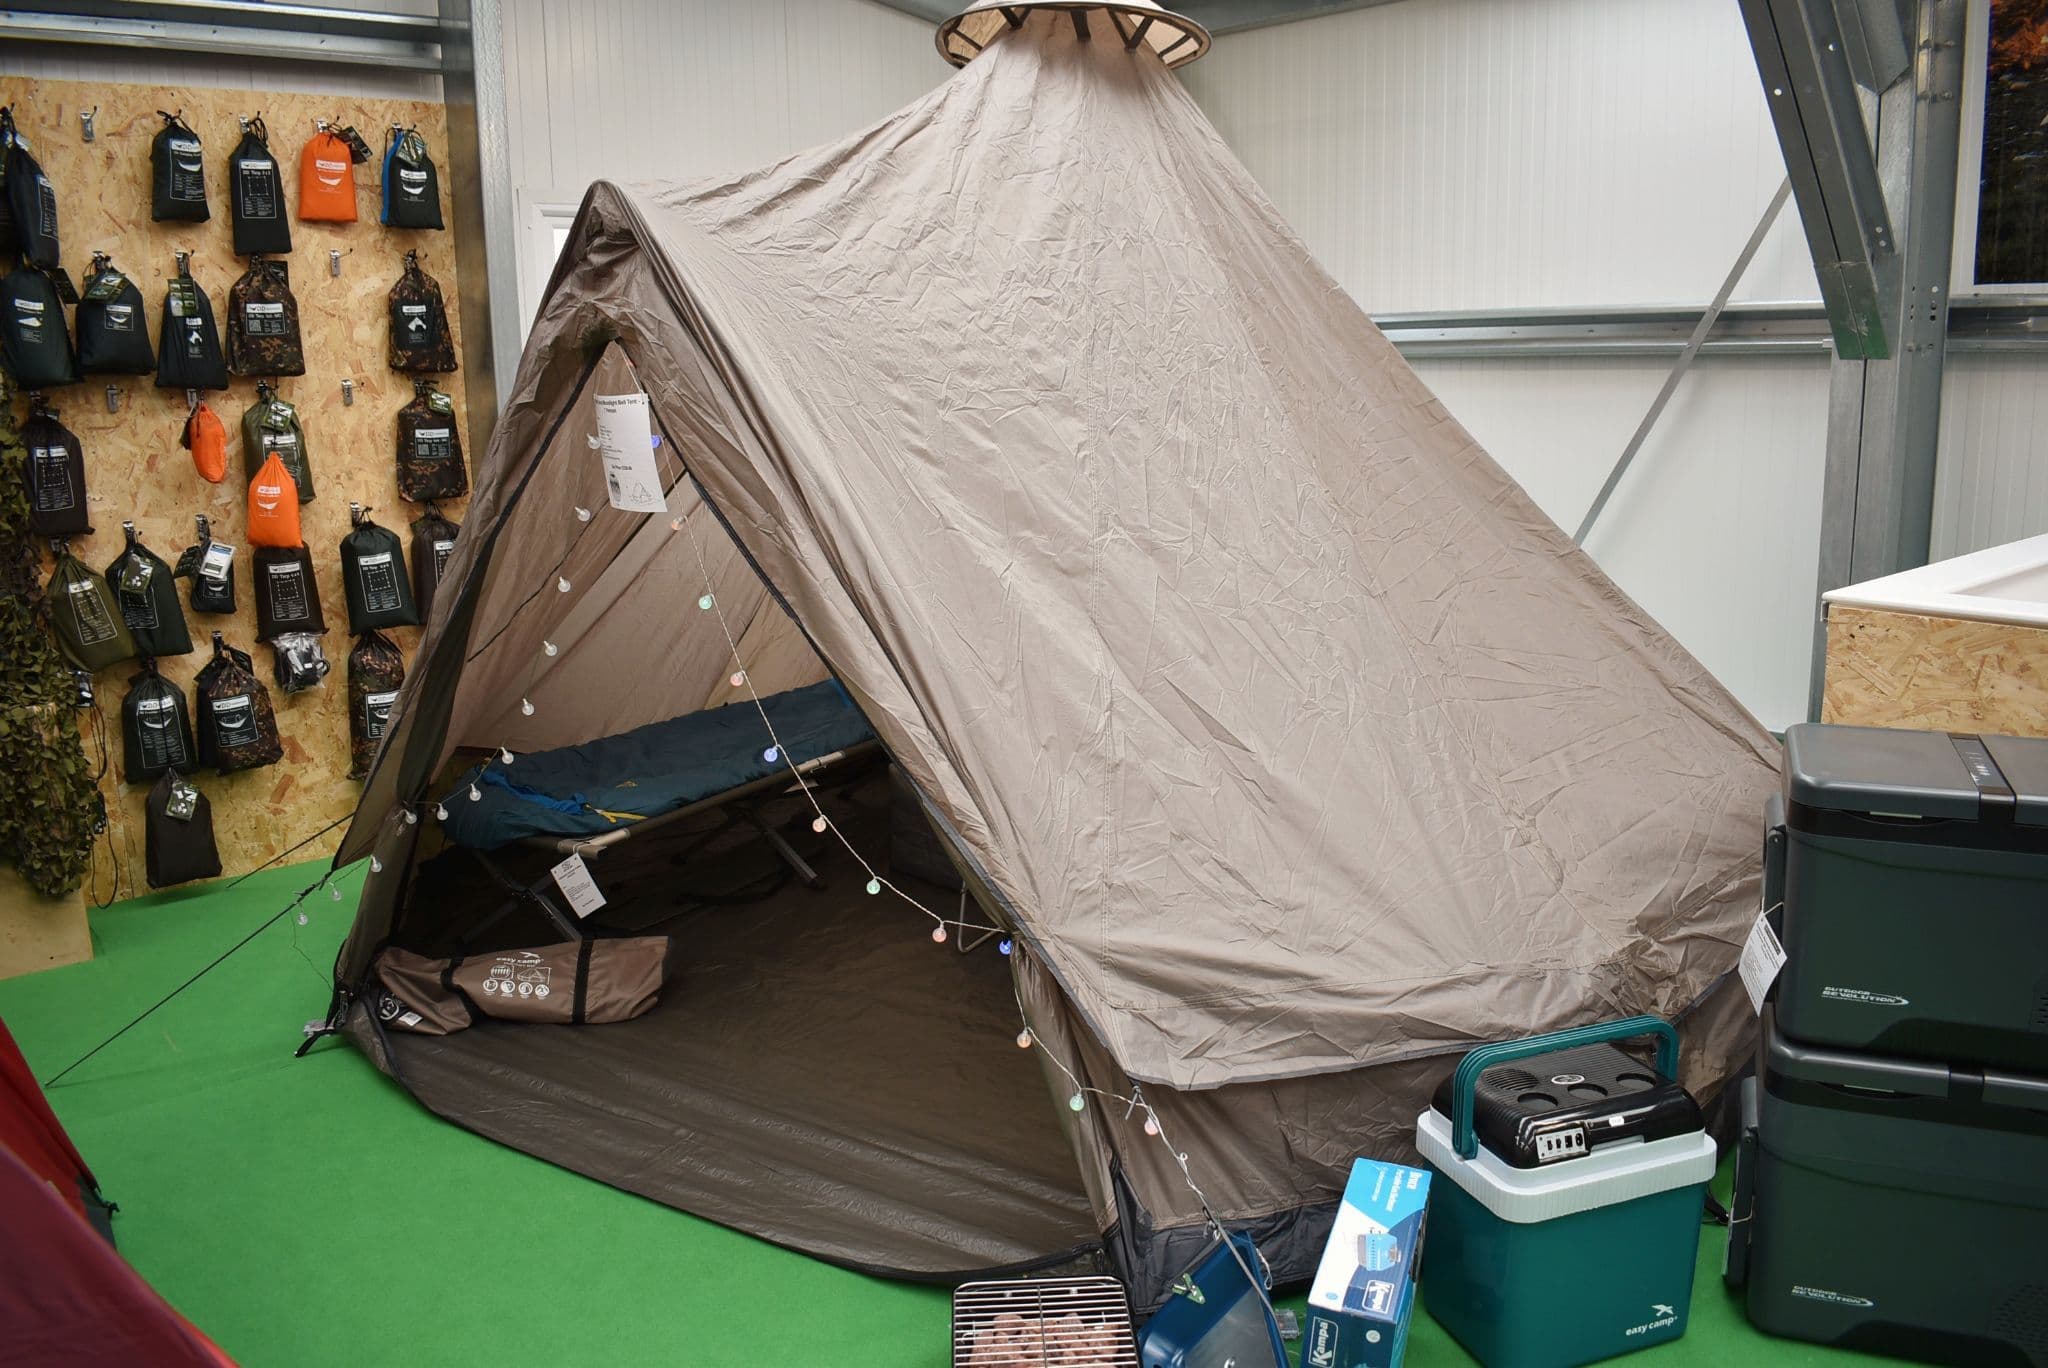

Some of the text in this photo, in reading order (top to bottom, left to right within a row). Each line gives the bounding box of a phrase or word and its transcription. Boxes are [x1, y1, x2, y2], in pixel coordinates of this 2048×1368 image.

[1822, 990, 1896, 1003] REVOLUTION
[1824, 986, 1871, 996] OUTDOOR
[1791, 1289, 1861, 1304] REVOLUTION
[1793, 1285, 1837, 1296] OUTDOOR
[1625, 1316, 1674, 1336] easy camp
[1312, 1320, 1334, 1366] Kampa
